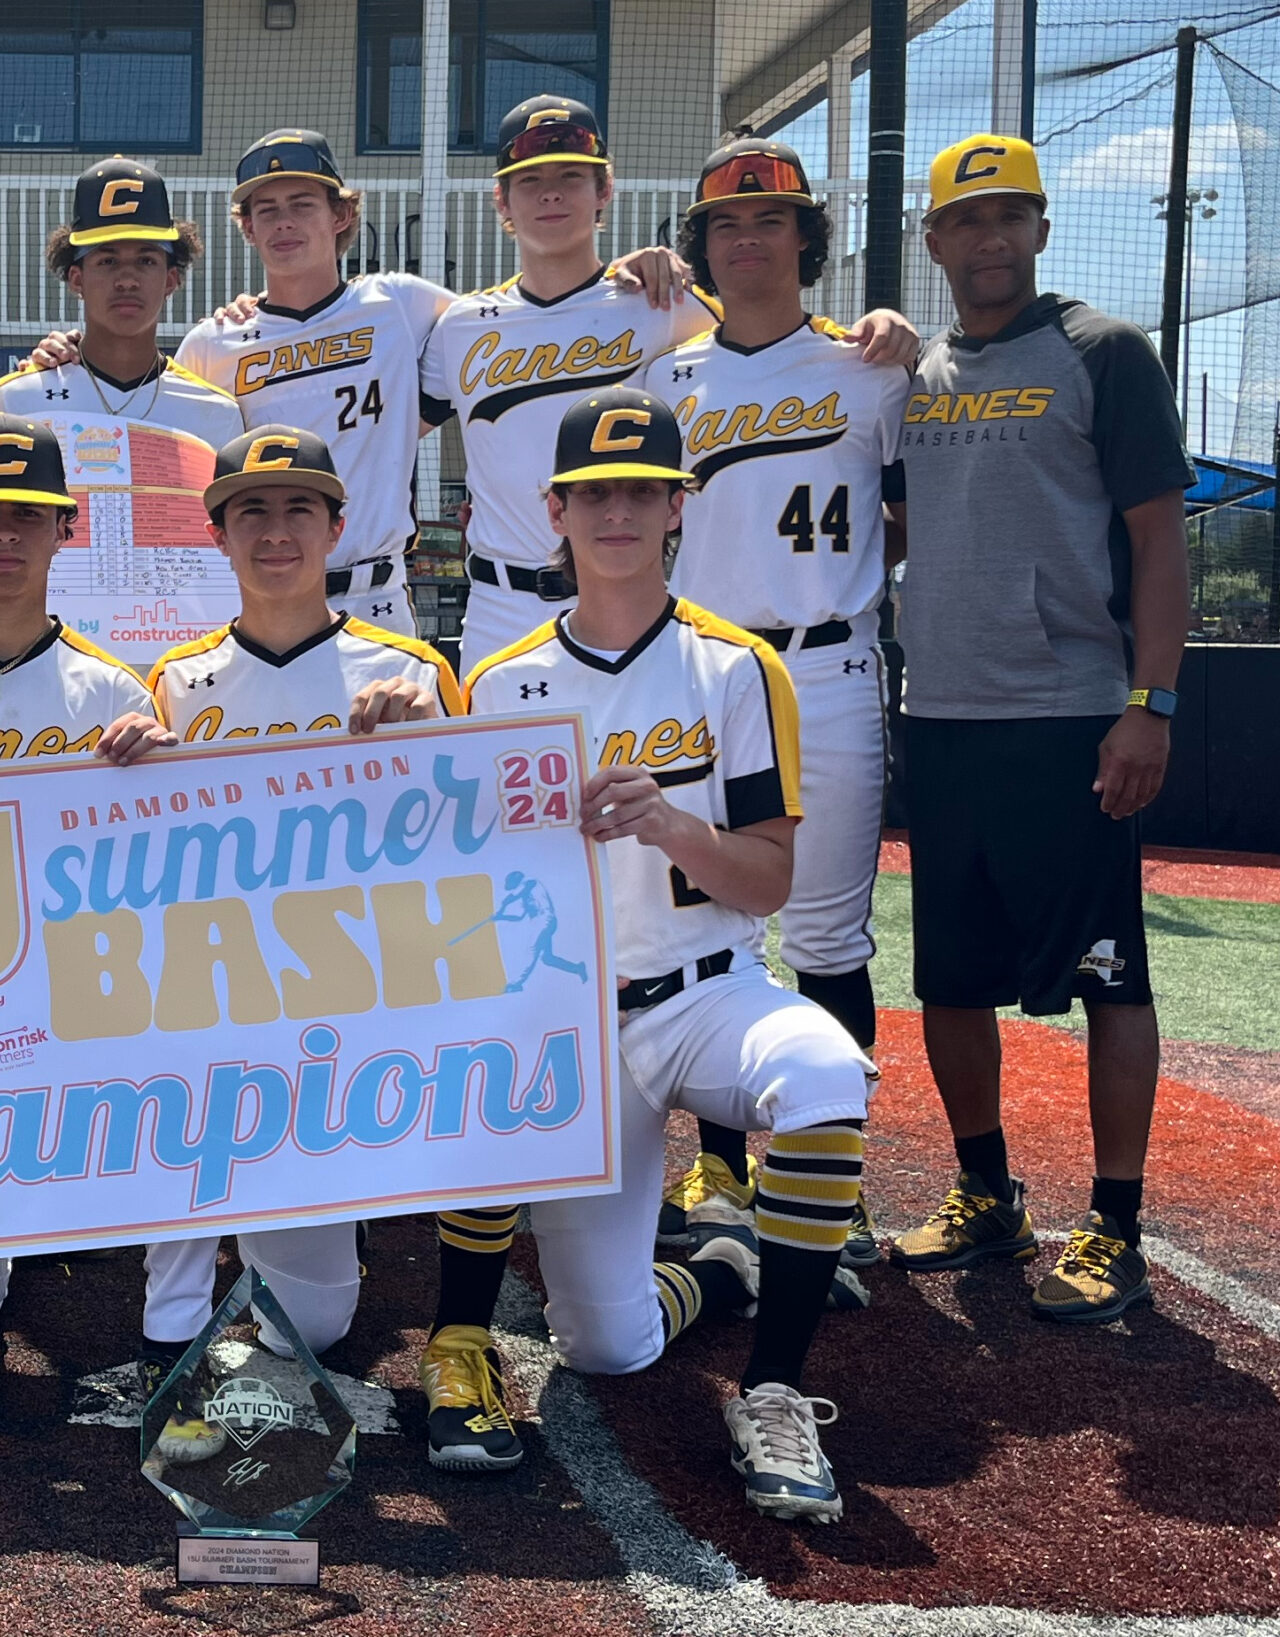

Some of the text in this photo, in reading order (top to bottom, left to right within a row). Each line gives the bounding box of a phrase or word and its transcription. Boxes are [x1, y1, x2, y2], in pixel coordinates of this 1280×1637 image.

[953, 146, 1006, 184] C
[98, 178, 145, 217] C
[234, 326, 376, 396] CANES
[458, 330, 642, 396] Canes
[333, 378, 384, 431] 24
[903, 387, 1058, 424] CANES
[590, 408, 652, 452] C
[904, 426, 1028, 447] BASEBALL
[242, 435, 300, 473] C
[776, 483, 851, 554] 44
[78, 619, 100, 634] by
[500, 752, 568, 790] 20
[60, 754, 412, 832] DIAMOND NATION
[506, 792, 570, 828] 24
[40, 754, 502, 924] summer
[42, 872, 508, 1044] BASH
[18, 1027, 48, 1047] risk
[208, 1402, 290, 1420] NATION
[226, 1547, 260, 1555] DIAMOND
[259, 1557, 310, 1565] TOURNAMENT
